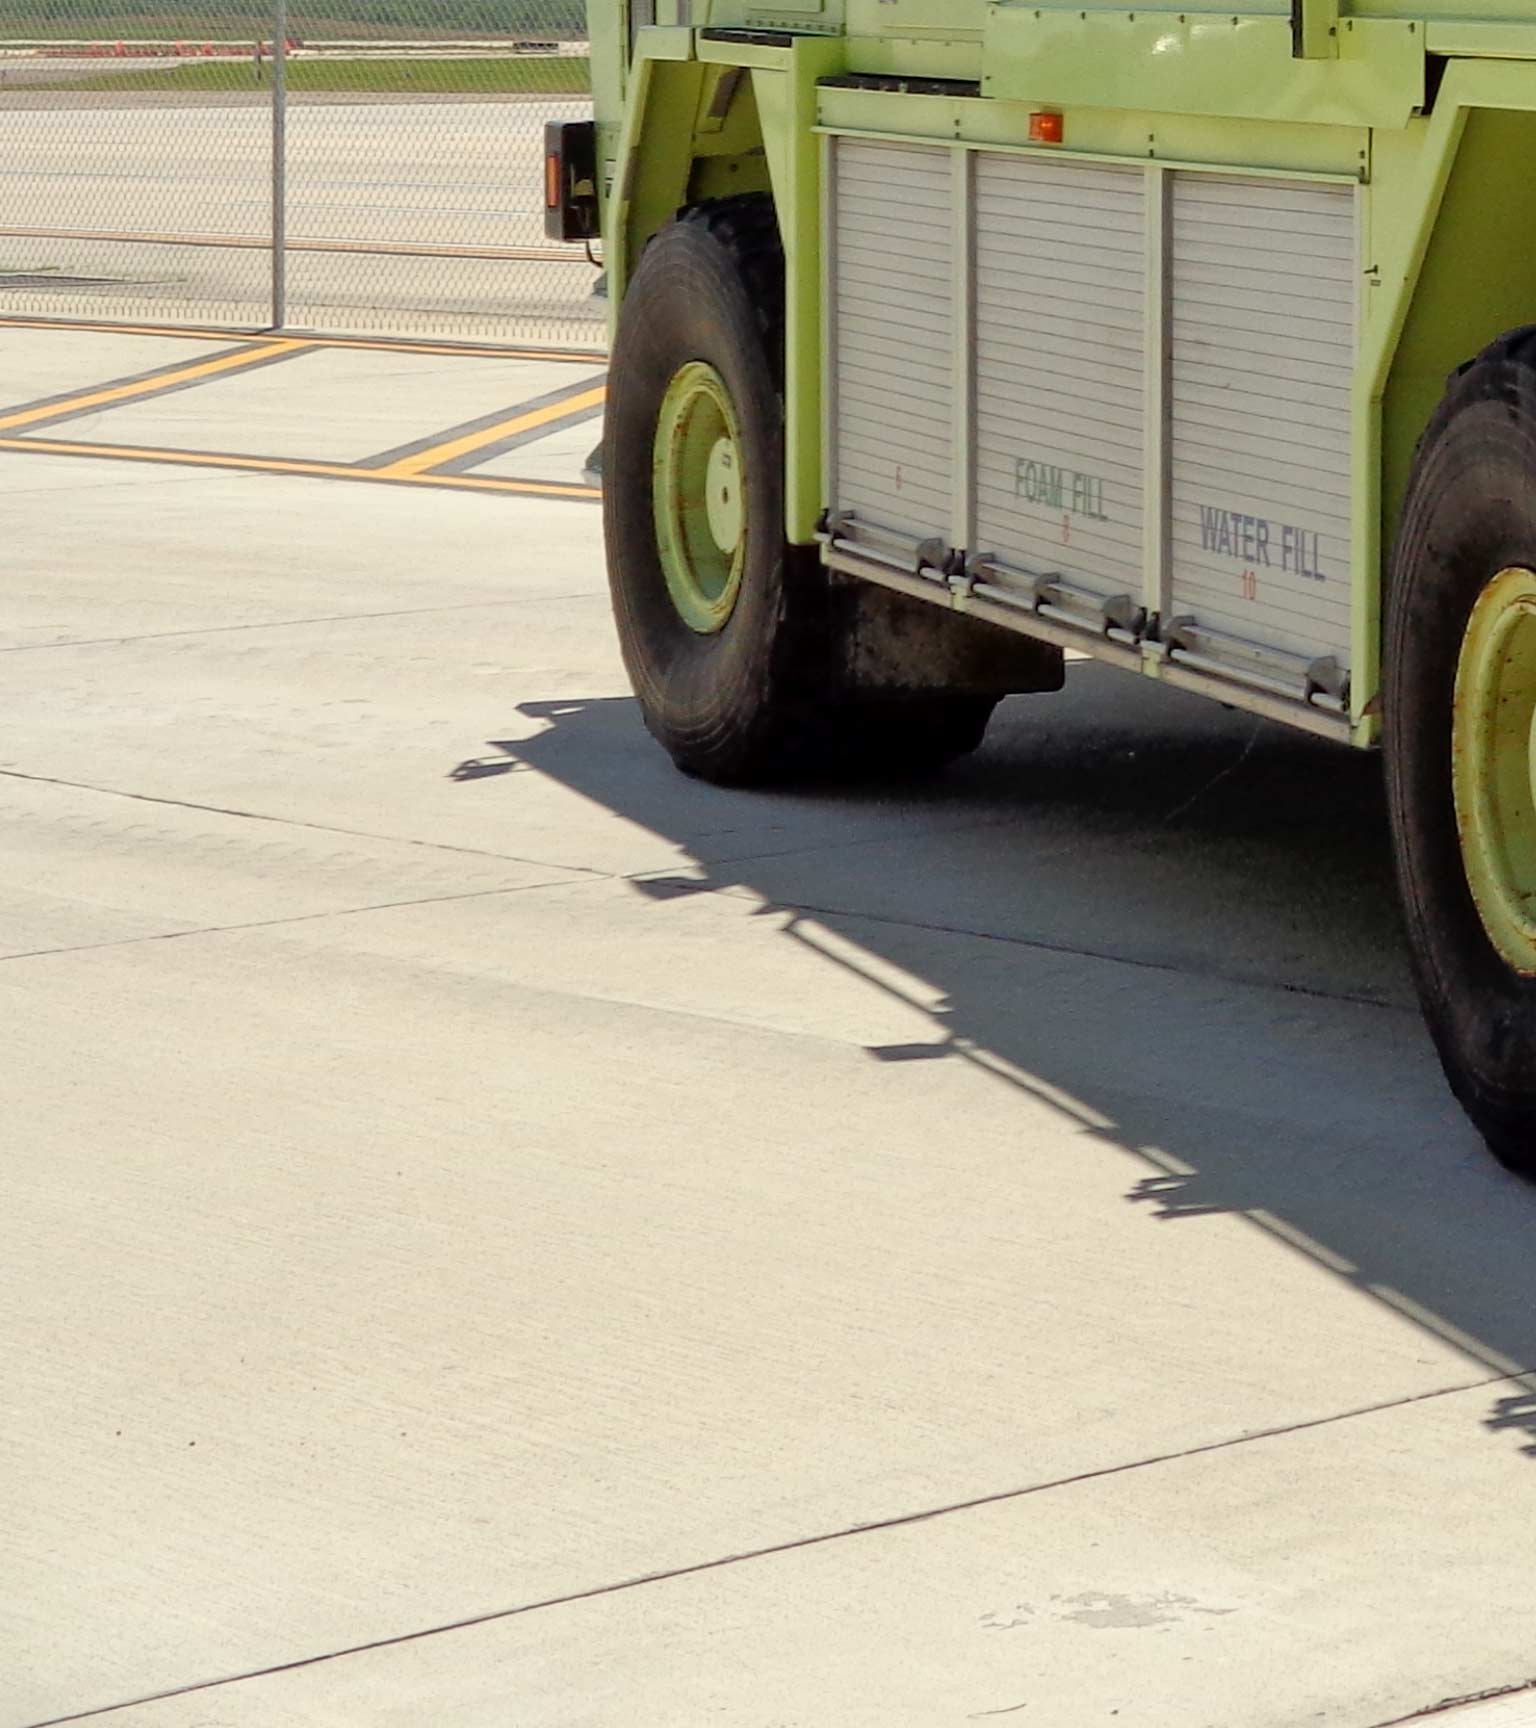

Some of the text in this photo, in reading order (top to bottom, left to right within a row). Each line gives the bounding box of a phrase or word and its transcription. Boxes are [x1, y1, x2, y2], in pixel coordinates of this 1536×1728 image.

[1015, 456, 1109, 521] FOAM FILL
[1199, 504, 1326, 582] WATER FILL
[1241, 569, 1256, 600] 10
